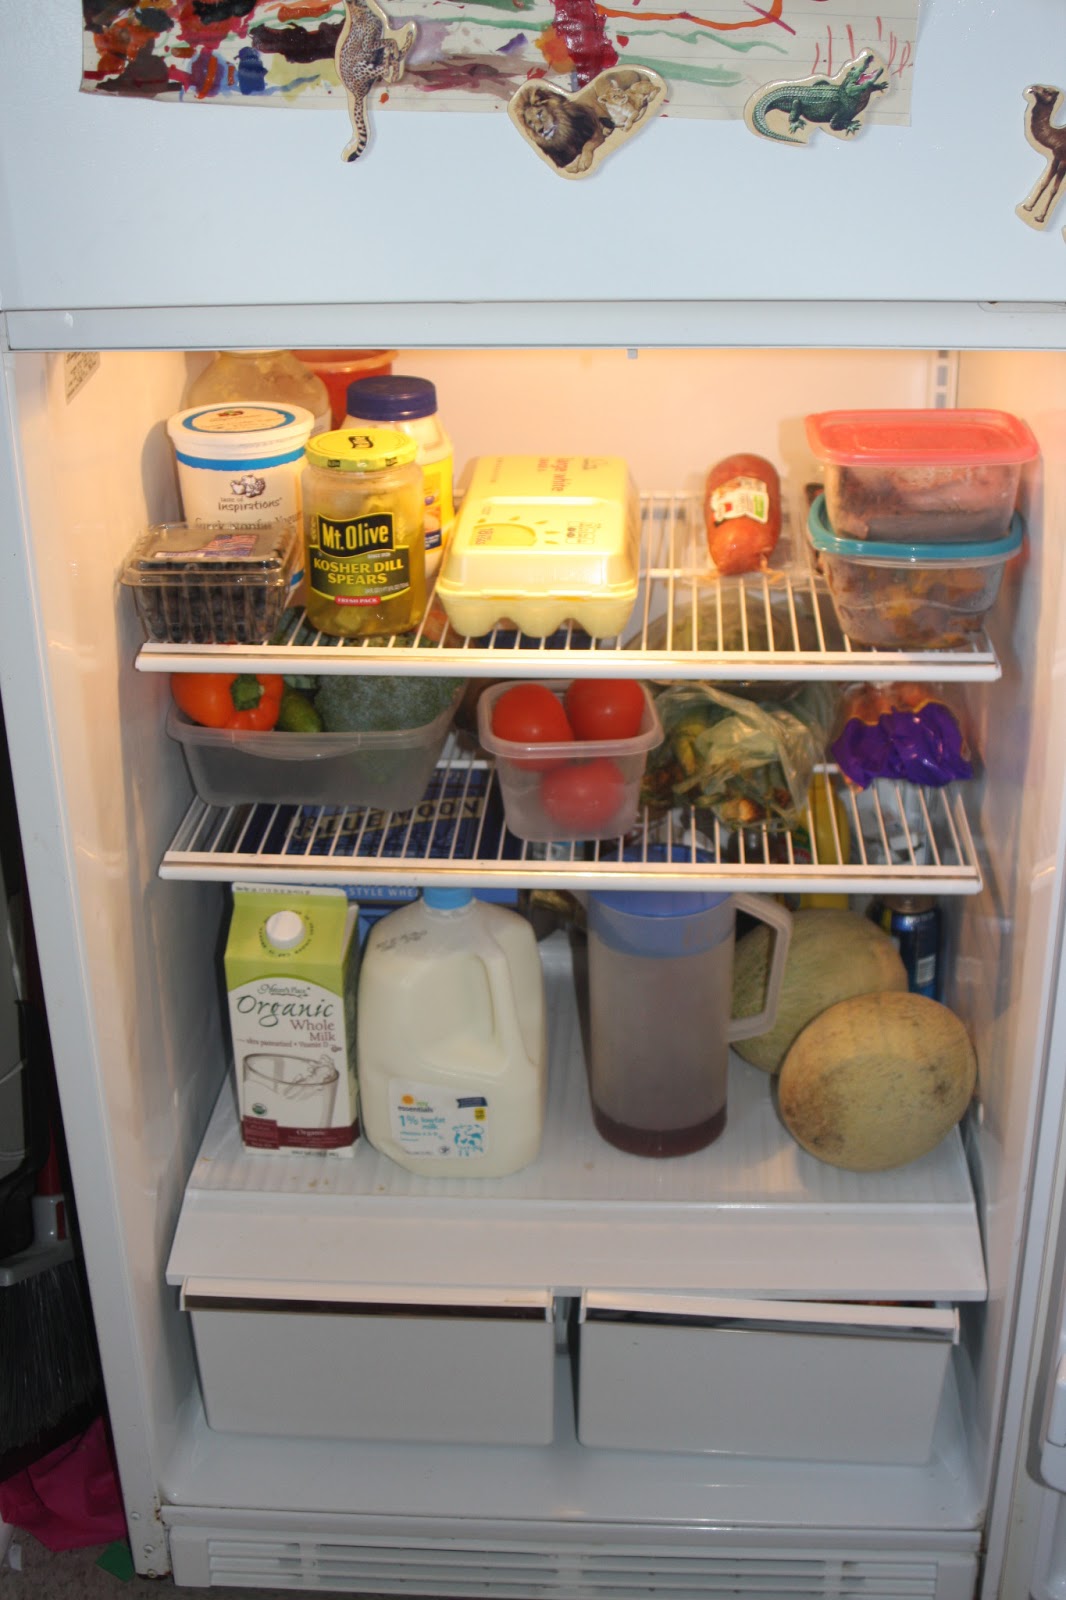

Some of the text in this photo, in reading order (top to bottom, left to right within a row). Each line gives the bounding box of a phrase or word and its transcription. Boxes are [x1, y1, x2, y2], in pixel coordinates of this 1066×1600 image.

[321, 522, 389, 551] Mt. Olive
[313, 557, 404, 574] KOSHER DILL
[327, 572, 388, 585] SPEARS
[348, 887, 383, 897] STYLE
[237, 995, 334, 1028] Organic
[290, 1019, 335, 1031] Whole
[309, 1031, 336, 1041] Milk
